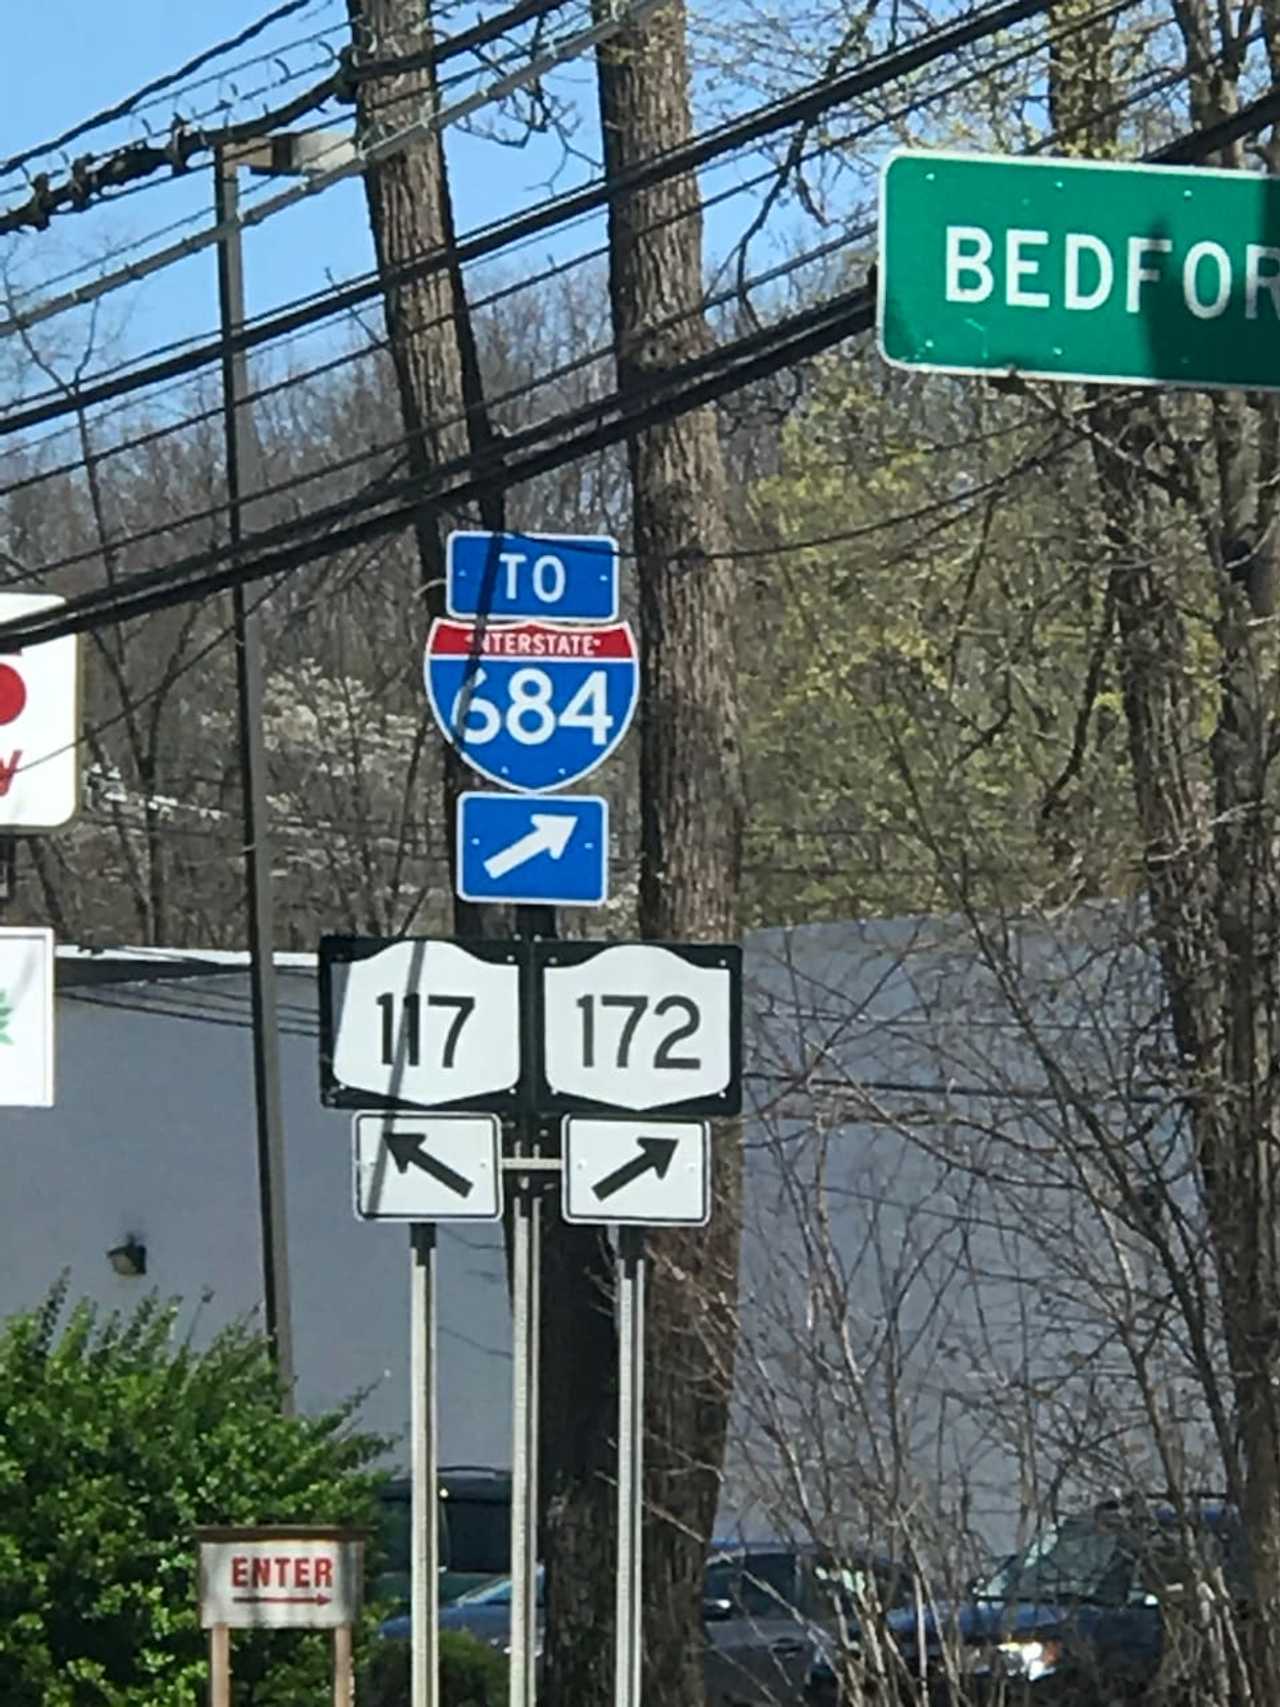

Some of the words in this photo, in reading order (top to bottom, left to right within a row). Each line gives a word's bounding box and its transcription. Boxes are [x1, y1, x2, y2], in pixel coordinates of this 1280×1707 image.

[499, 553, 566, 603] TO
[471, 632, 595, 655] NTERSTATE
[451, 667, 614, 745] 684
[376, 992, 476, 1068] 117
[576, 994, 702, 1070] 172
[231, 1557, 333, 1588] ENTER
